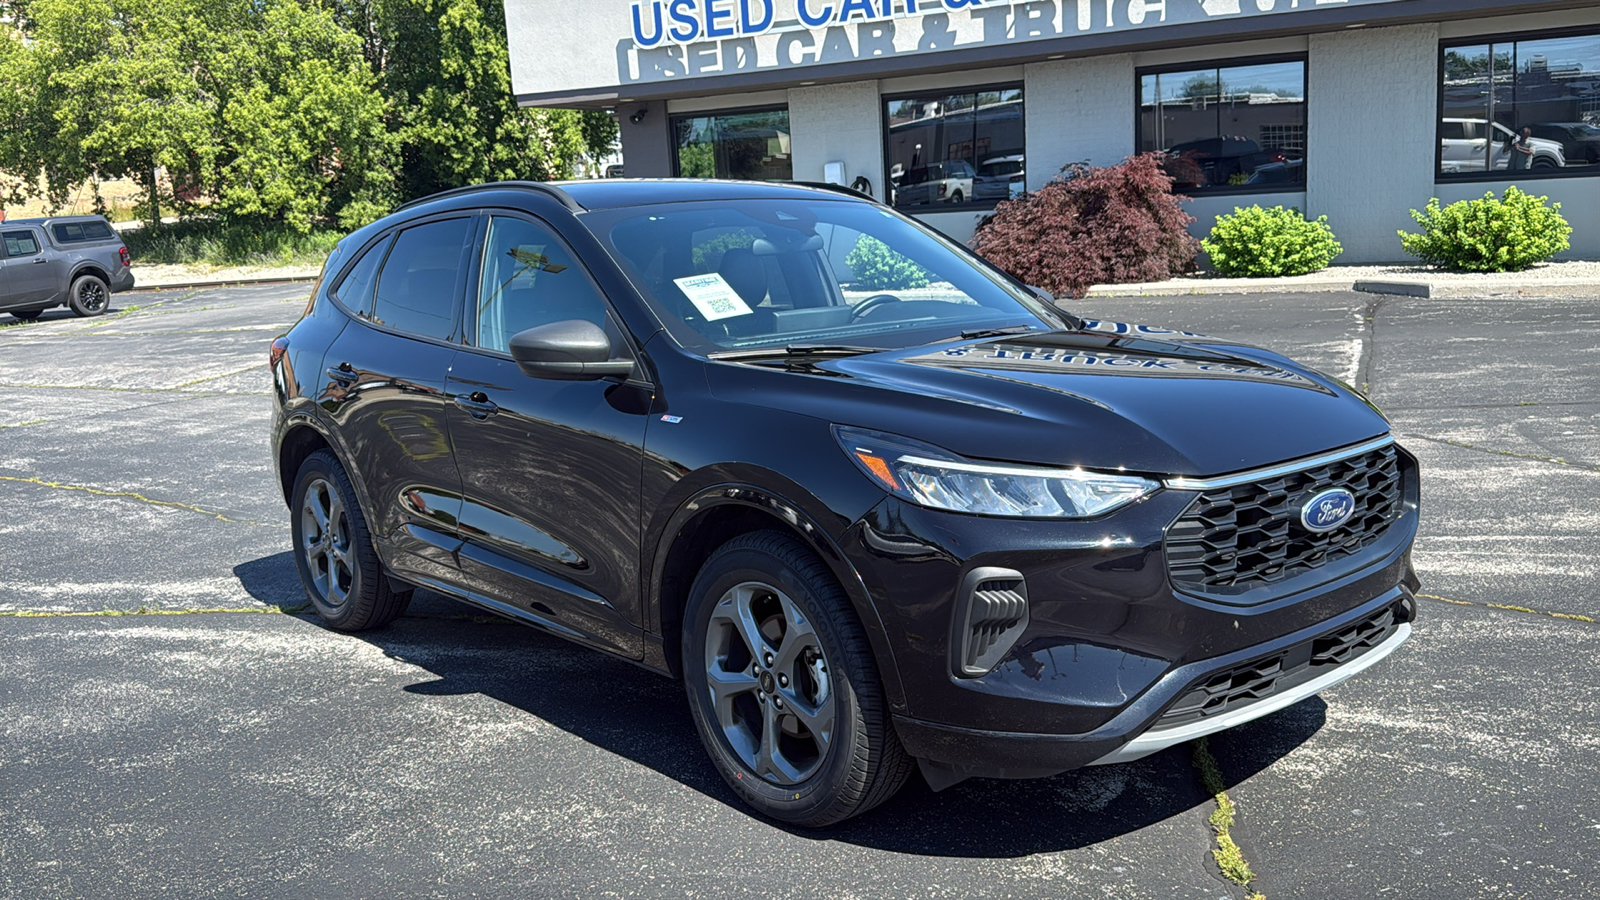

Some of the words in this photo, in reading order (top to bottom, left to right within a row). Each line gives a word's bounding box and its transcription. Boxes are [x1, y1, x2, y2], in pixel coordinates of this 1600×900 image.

[630, 0, 775, 48] USED
[1317, 497, 1346, 524] Ford
[802, 591, 847, 692] YOKOHAMA
